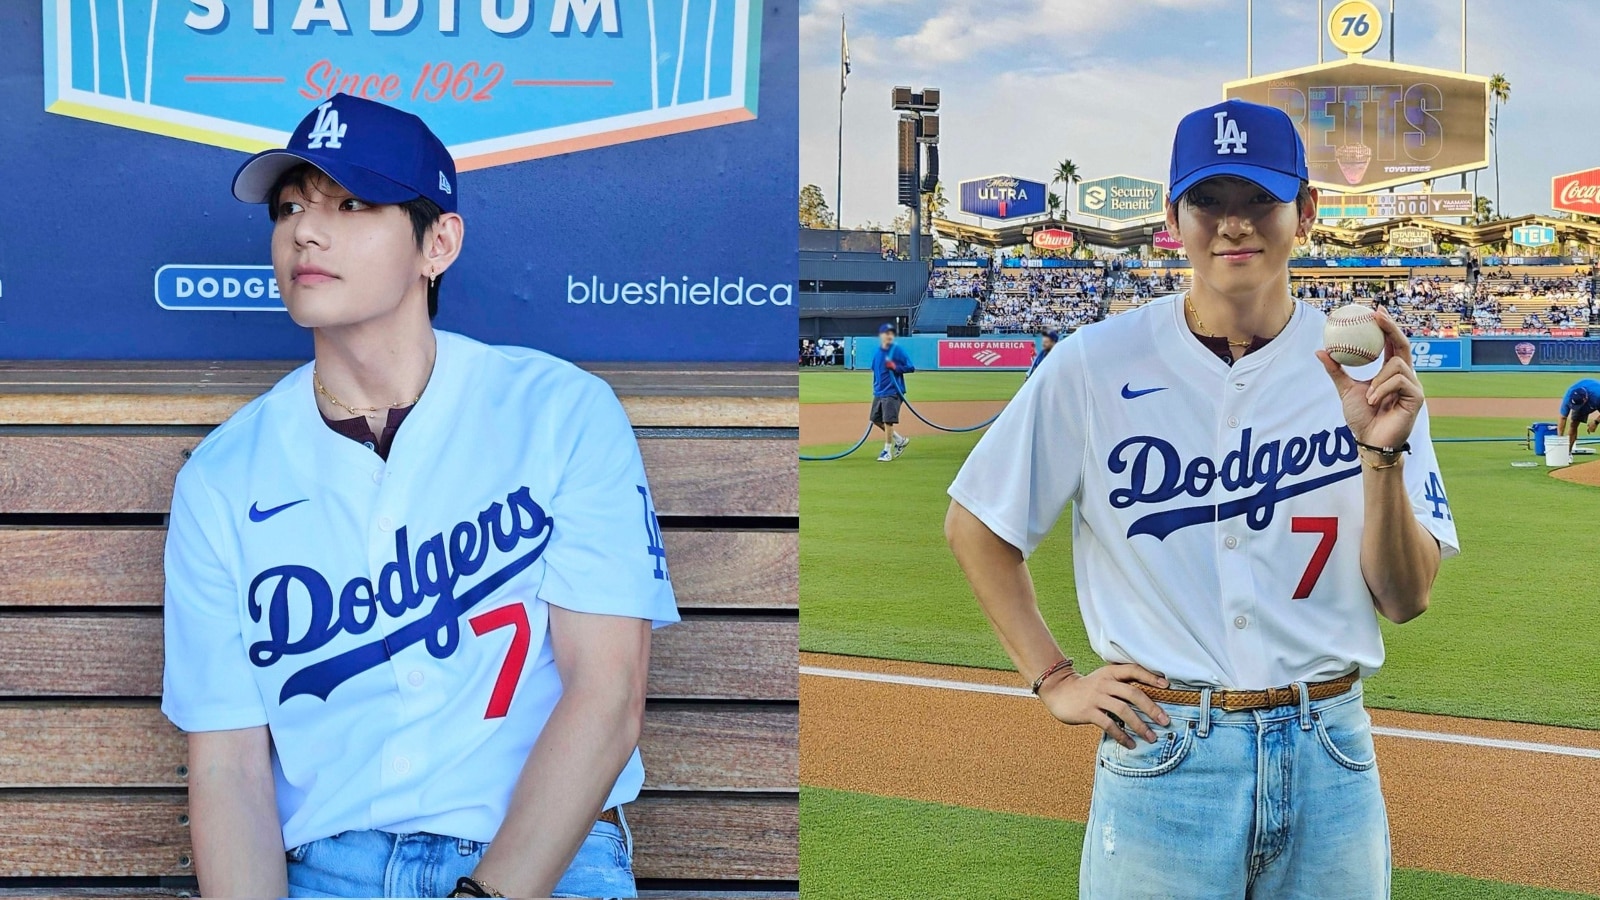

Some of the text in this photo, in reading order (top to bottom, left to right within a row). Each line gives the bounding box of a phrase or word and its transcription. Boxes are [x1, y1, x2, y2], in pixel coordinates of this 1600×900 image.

[184, 0, 622, 36] STADIUM
[1341, 13, 1370, 37] 76
[299, 58, 506, 101] Since 1962
[307, 101, 348, 149] LA
[1213, 111, 1248, 155] LA
[978, 188, 1028, 200] ULTRA
[1110, 186, 1157, 201] Security
[1560, 179, 1600, 205] Coca
[1111, 198, 1152, 211] Benefit
[1035, 232, 1071, 245] Churu
[1392, 231, 1428, 239] STARLUX
[1518, 228, 1551, 243] TEL
[176, 277, 281, 298] DODGE
[567, 275, 793, 306] blueshieldca
[1410, 342, 1431, 355] YO
[1411, 354, 1443, 367] RES
[1540, 341, 1600, 361] MOOKIE
[1107, 426, 1361, 532] Dodgers
[1291, 516, 1339, 600] 7
[248, 486, 553, 670] Dodgers
[468, 602, 532, 720] 7
